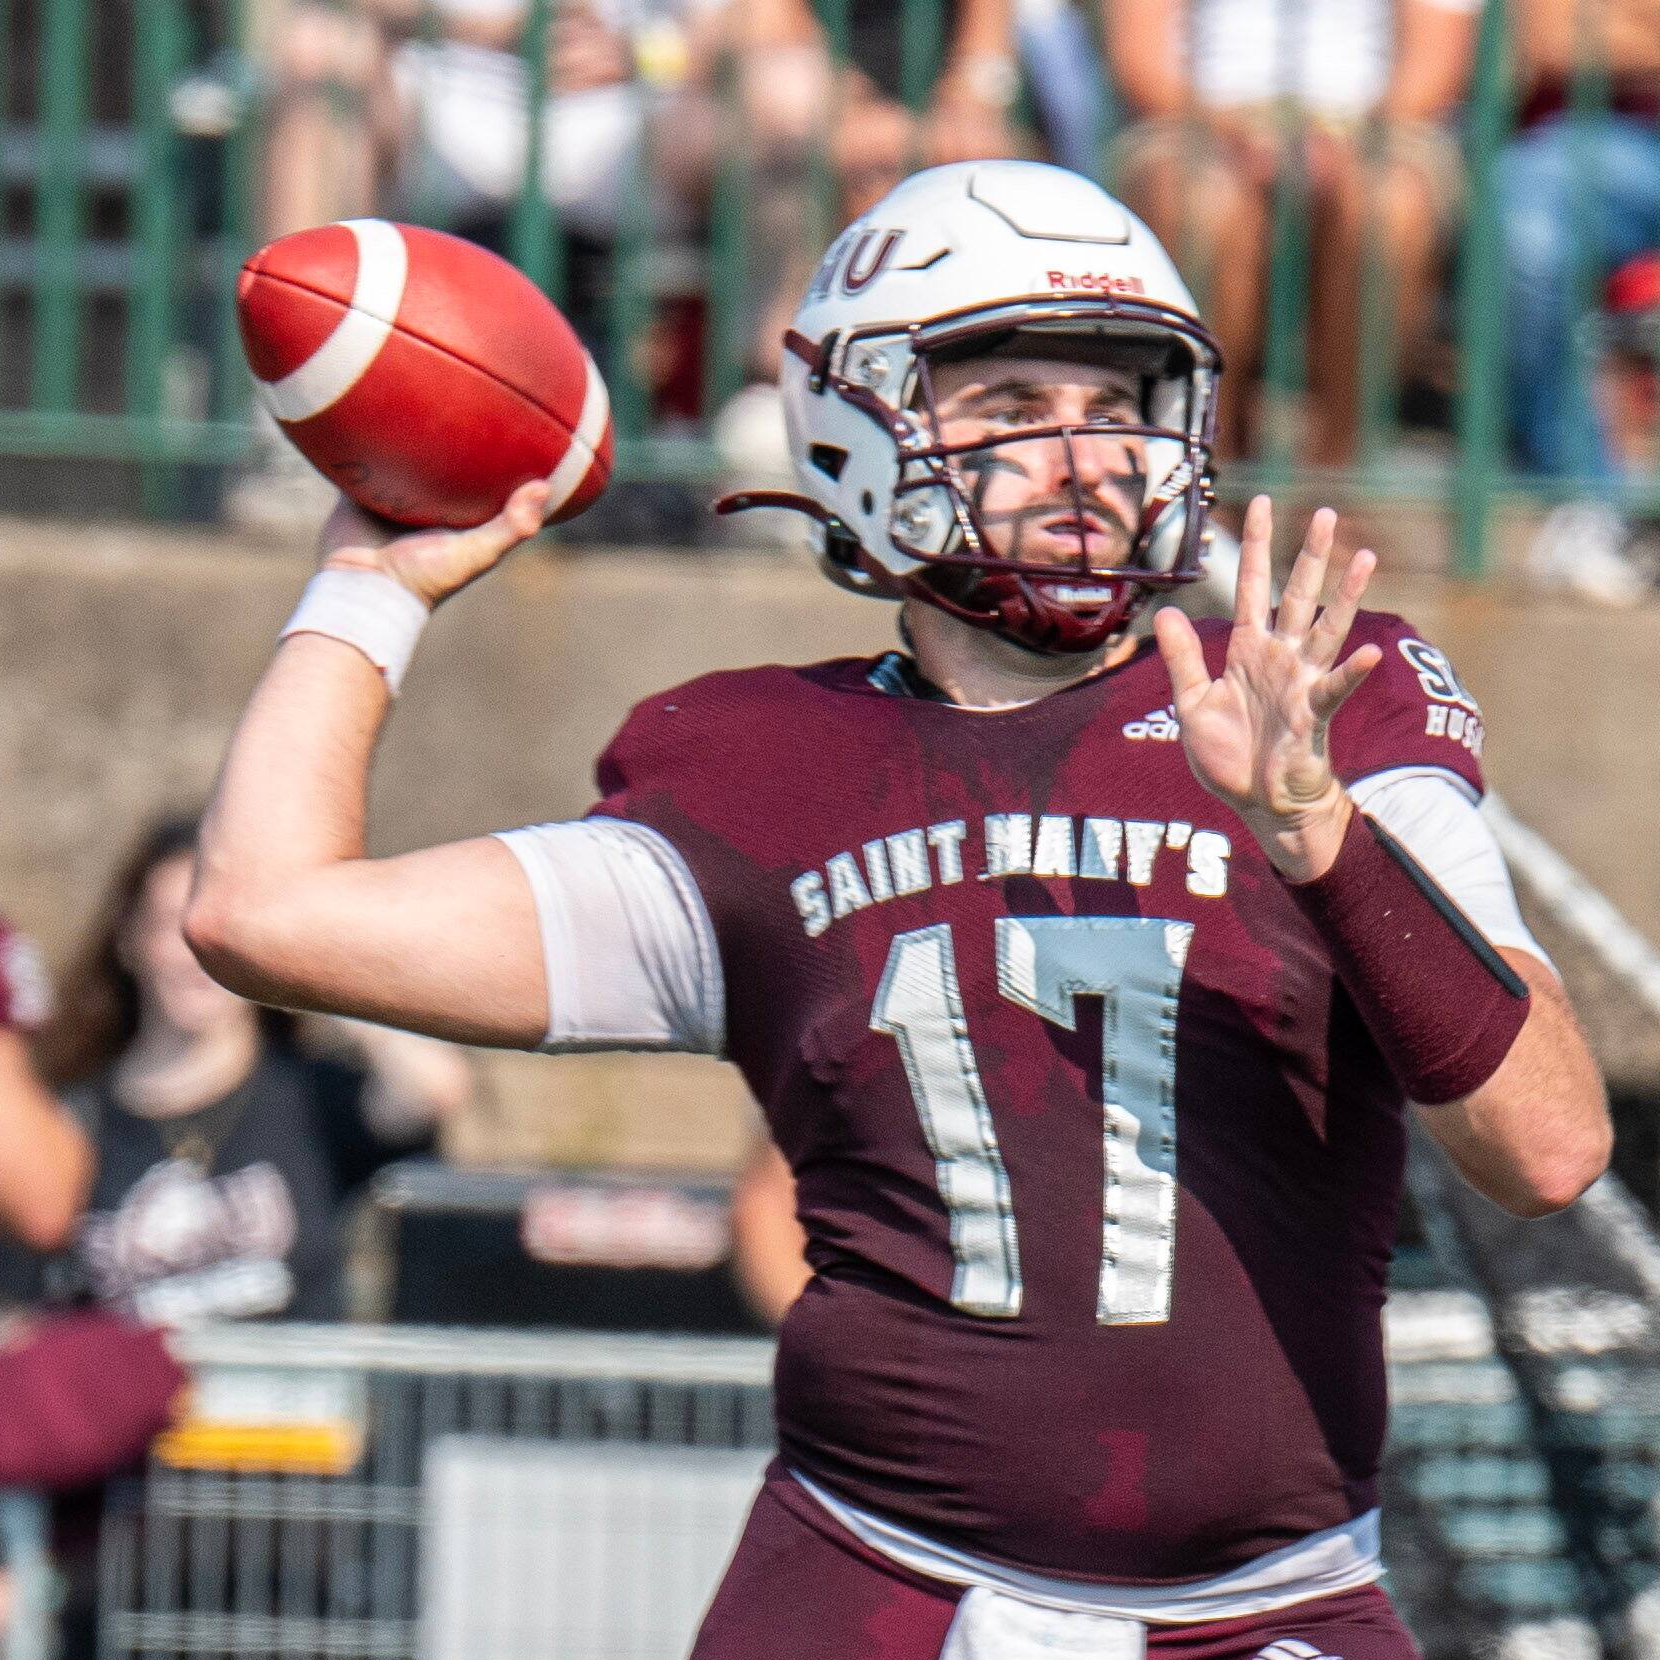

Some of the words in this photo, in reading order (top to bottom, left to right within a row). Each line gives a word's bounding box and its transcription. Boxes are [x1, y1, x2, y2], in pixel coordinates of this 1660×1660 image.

[790, 817, 967, 939] SAINT
[977, 811, 1231, 897] MARY'S
[868, 915, 1196, 1325] 17
